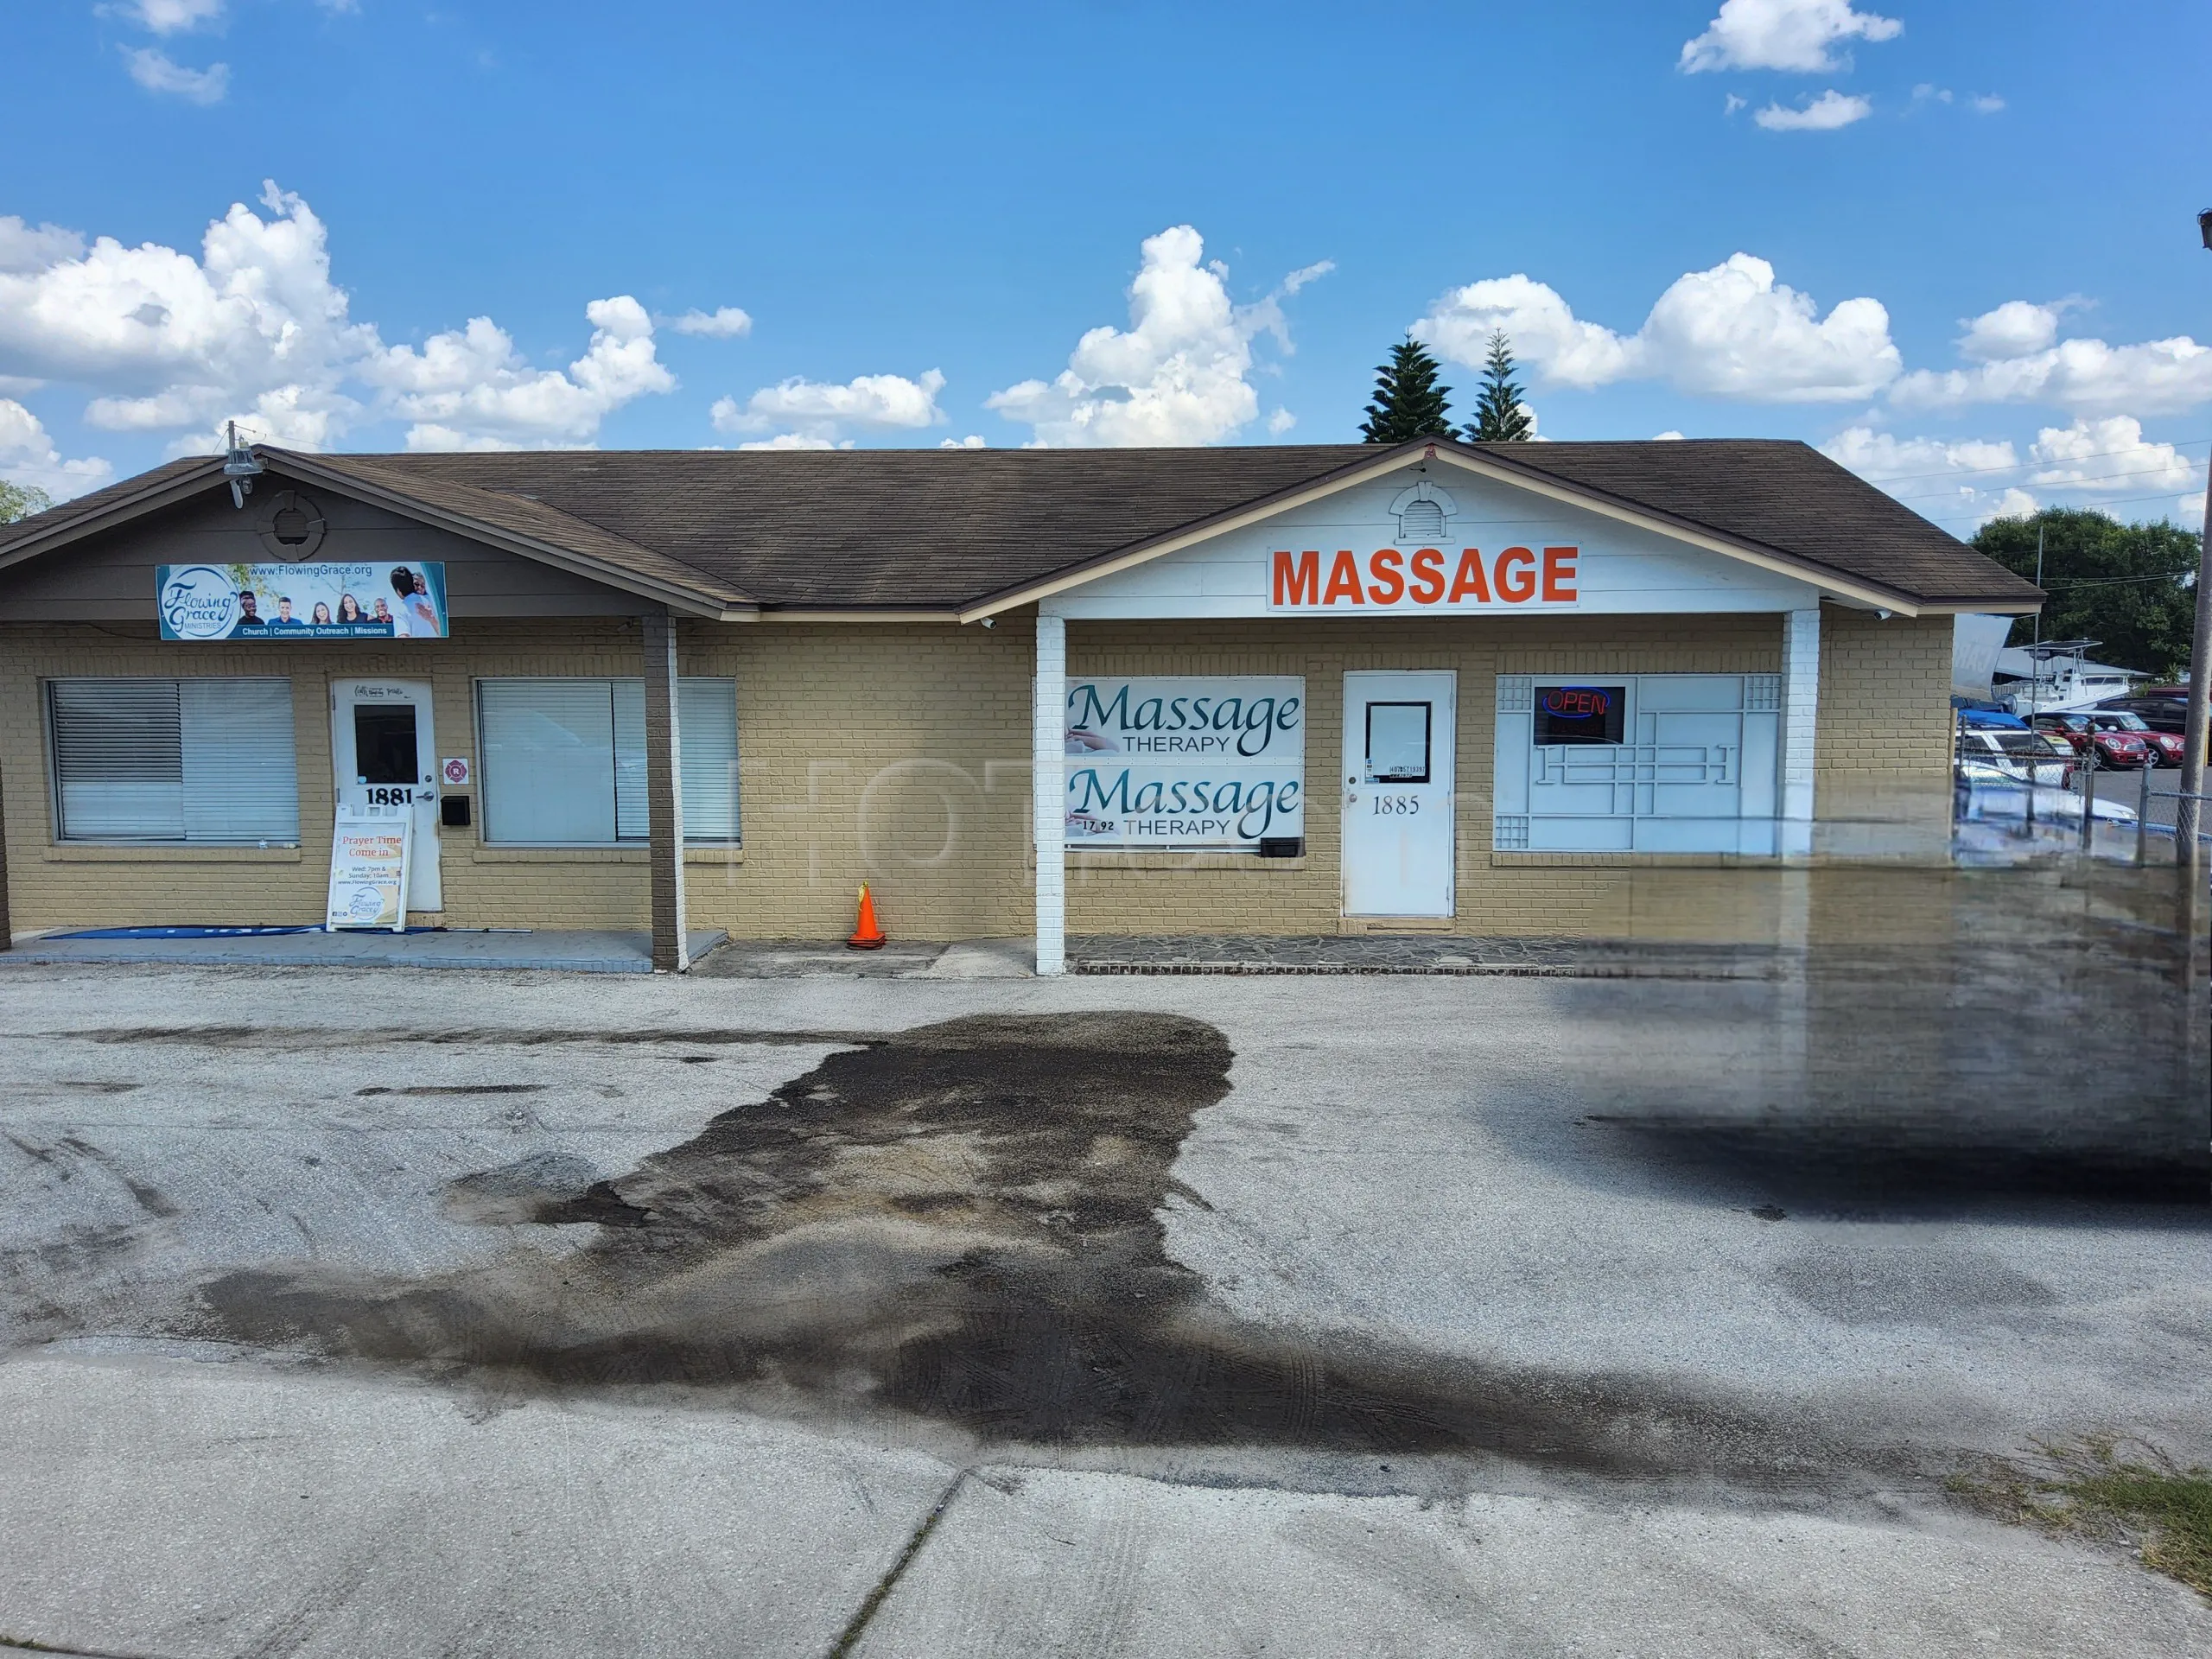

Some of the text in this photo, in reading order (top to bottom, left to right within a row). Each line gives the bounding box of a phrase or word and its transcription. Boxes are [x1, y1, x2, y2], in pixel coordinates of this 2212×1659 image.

[249, 564, 372, 577] www.FlowingGrace.org
[1273, 546, 1579, 606] MASSAGE
[164, 582, 238, 621] Flowing
[169, 607, 217, 632] Grace
[242, 626, 387, 637] Church Community Outreach Missions
[1548, 690, 1606, 715] OPEN
[1068, 683, 1300, 757] Massage
[1122, 736, 1230, 752] THERAPY
[365, 787, 412, 807] 1881
[1069, 767, 1299, 840] Massage
[1372, 795, 1420, 816] 1885
[1083, 820, 1115, 830] 17 92
[1123, 820, 1230, 835] THERAPY
[342, 835, 402, 846] Prayer Time
[349, 847, 389, 857] Come in
